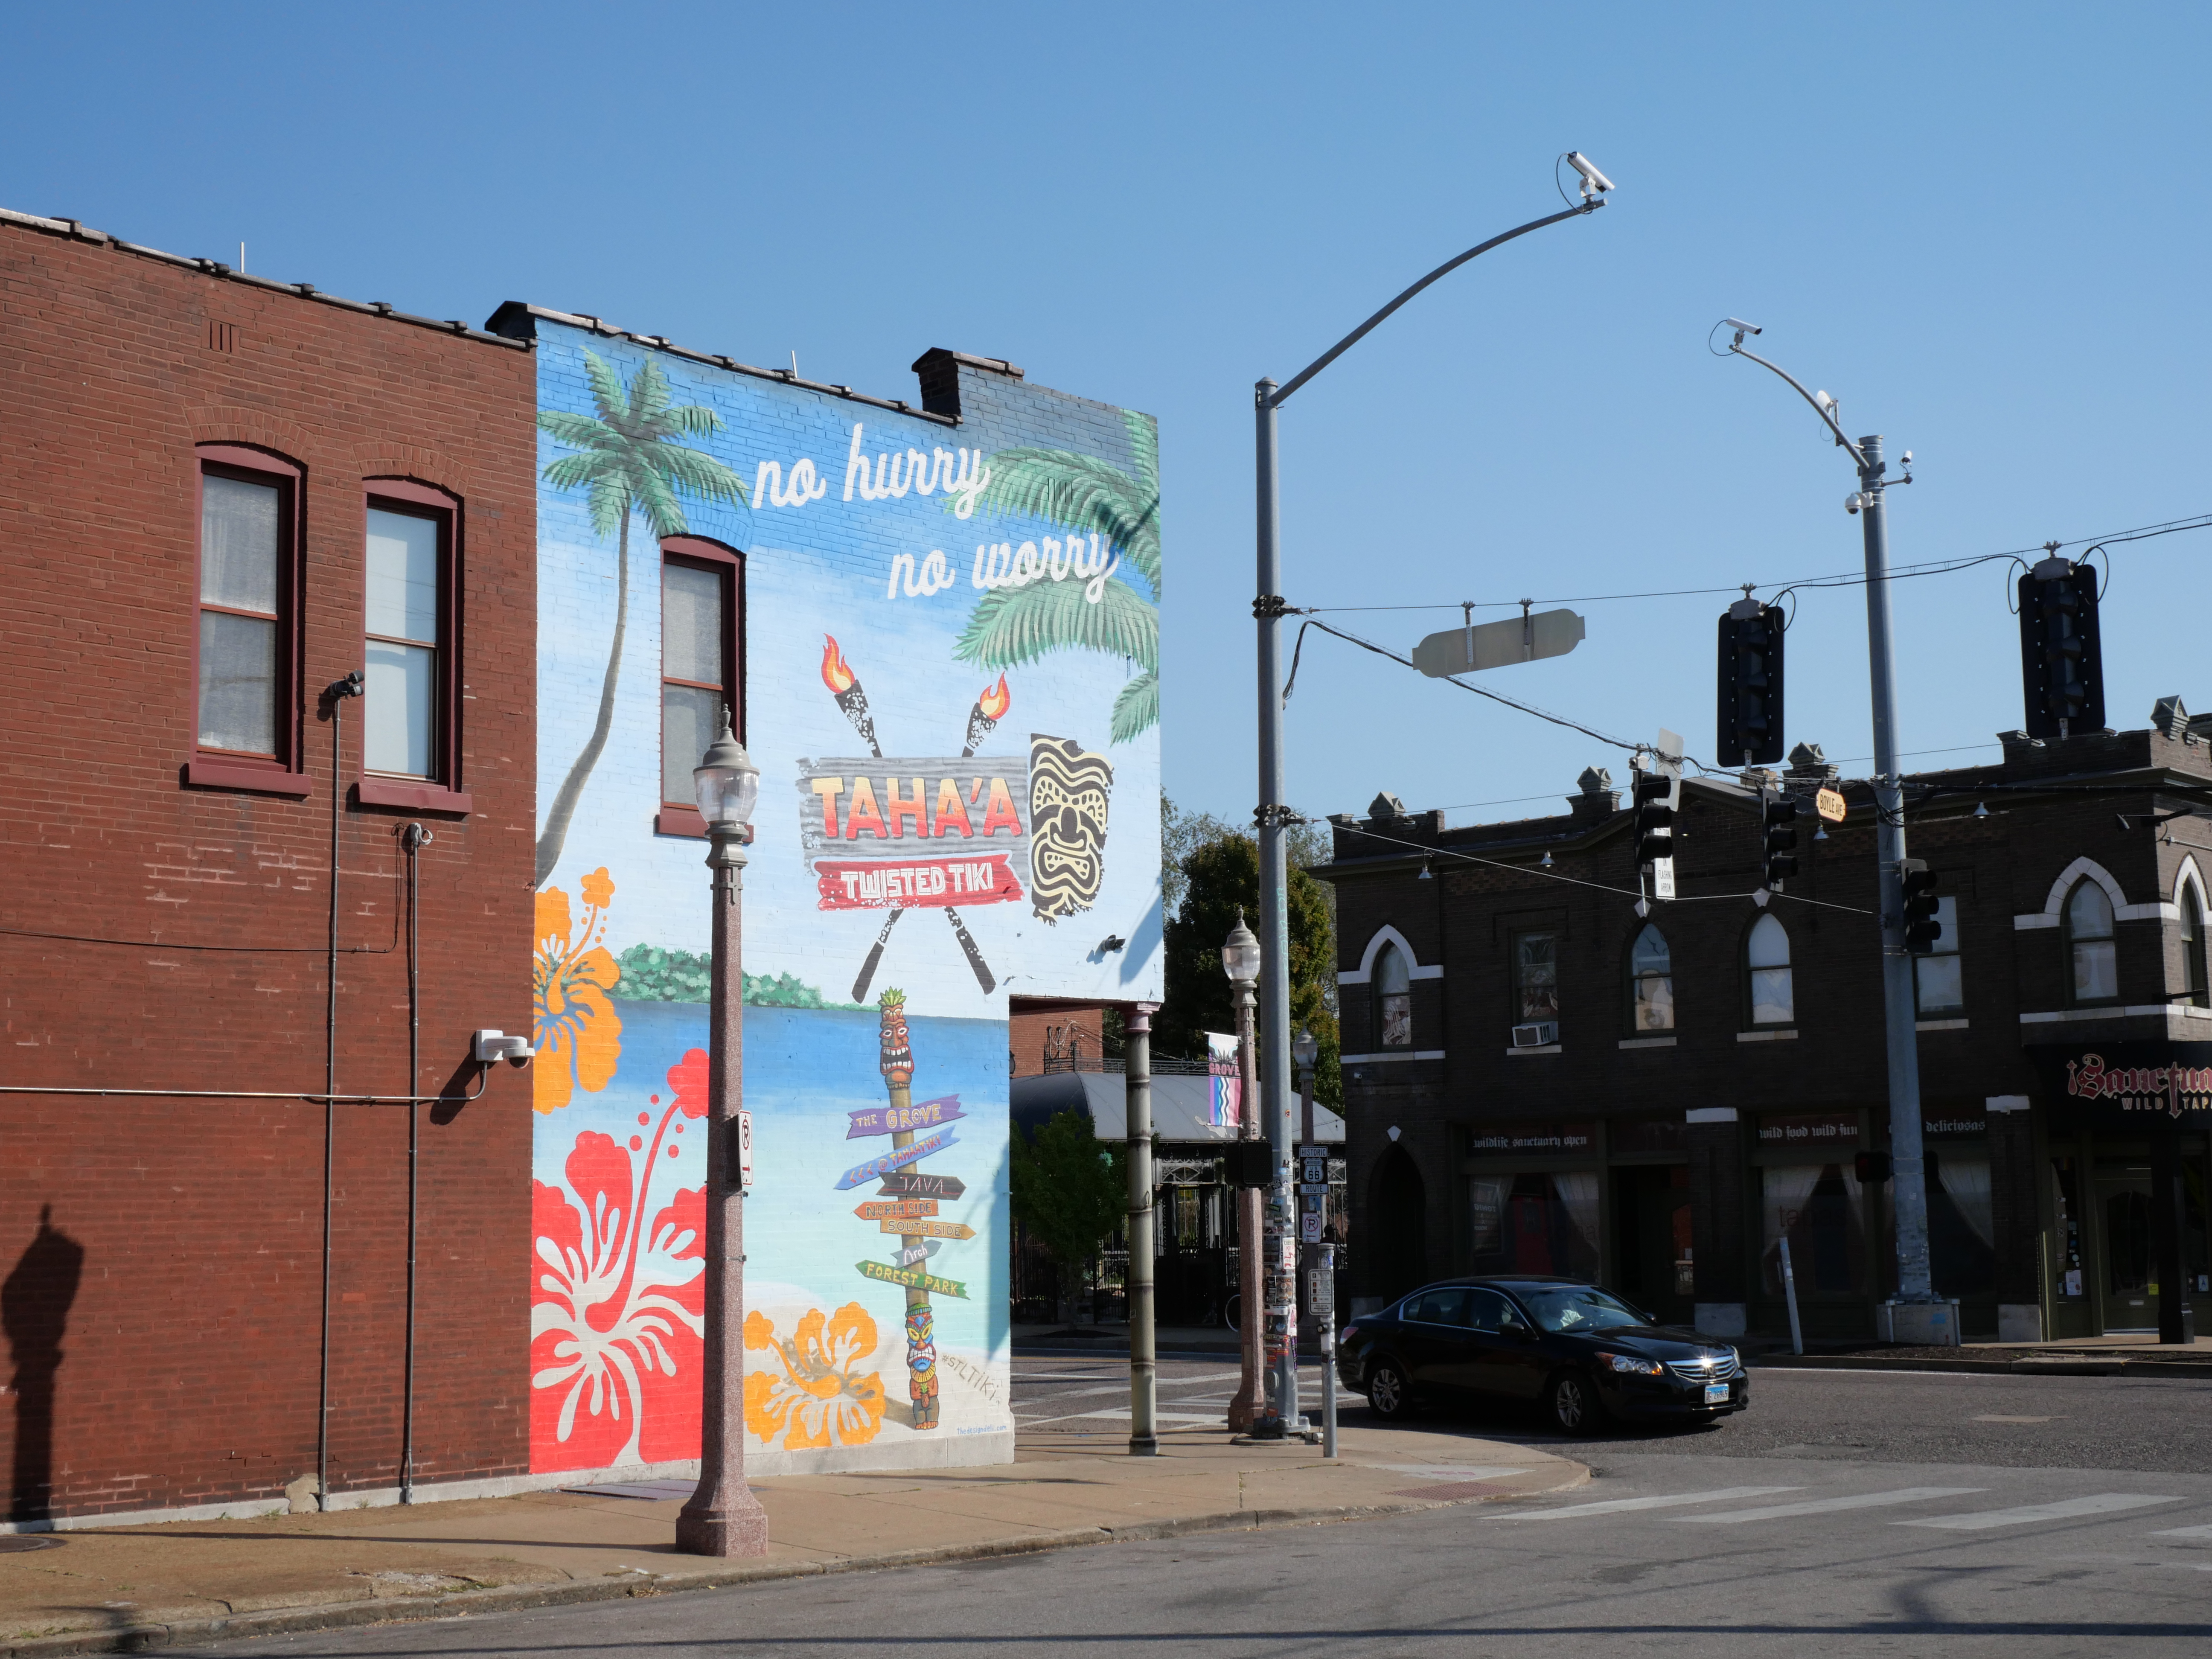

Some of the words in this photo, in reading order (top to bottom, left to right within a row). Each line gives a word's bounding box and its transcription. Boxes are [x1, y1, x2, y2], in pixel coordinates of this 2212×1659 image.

[752, 458, 827, 509] no
[843, 422, 990, 519] hurry
[888, 549, 955, 599] no
[972, 533, 1120, 604] worry
[812, 777, 1023, 840] TAHA'A
[1820, 794, 1835, 813] BOYLE
[841, 867, 946, 899] TWISTED
[949, 863, 993, 892] TIKI
[1658, 870, 1672, 880] FLASHING
[1209, 1062, 1241, 1076] GROVE
[2122, 1097, 2164, 1110] WILD
[2183, 1097, 2212, 1109] TAP
[856, 1115, 877, 1127] THE
[886, 1103, 941, 1129] GROVE
[1759, 1126, 1782, 1140] wild
[1786, 1125, 1808, 1141] food
[1812, 1125, 1836, 1136] wild
[1839, 1123, 1858, 1137] fun
[1925, 1119, 1985, 1133] deliciosas
[1473, 1136, 1508, 1148] wildlife
[1512, 1136, 1560, 1148] sanctuary
[1563, 1135, 1587, 1147] open
[1308, 1170, 1319, 1179] 66
[866, 1202, 905, 1217] NORTH
[908, 1202, 932, 1215] SIDE
[888, 1220, 929, 1234] SOUTH
[934, 1225, 961, 1237] SIDE
[904, 1244, 928, 1264] Arch
[866, 1263, 918, 1286] FOREST
[924, 1275, 959, 1295] PARK
[957, 1424, 1007, 1435] thedesigndeli.com
